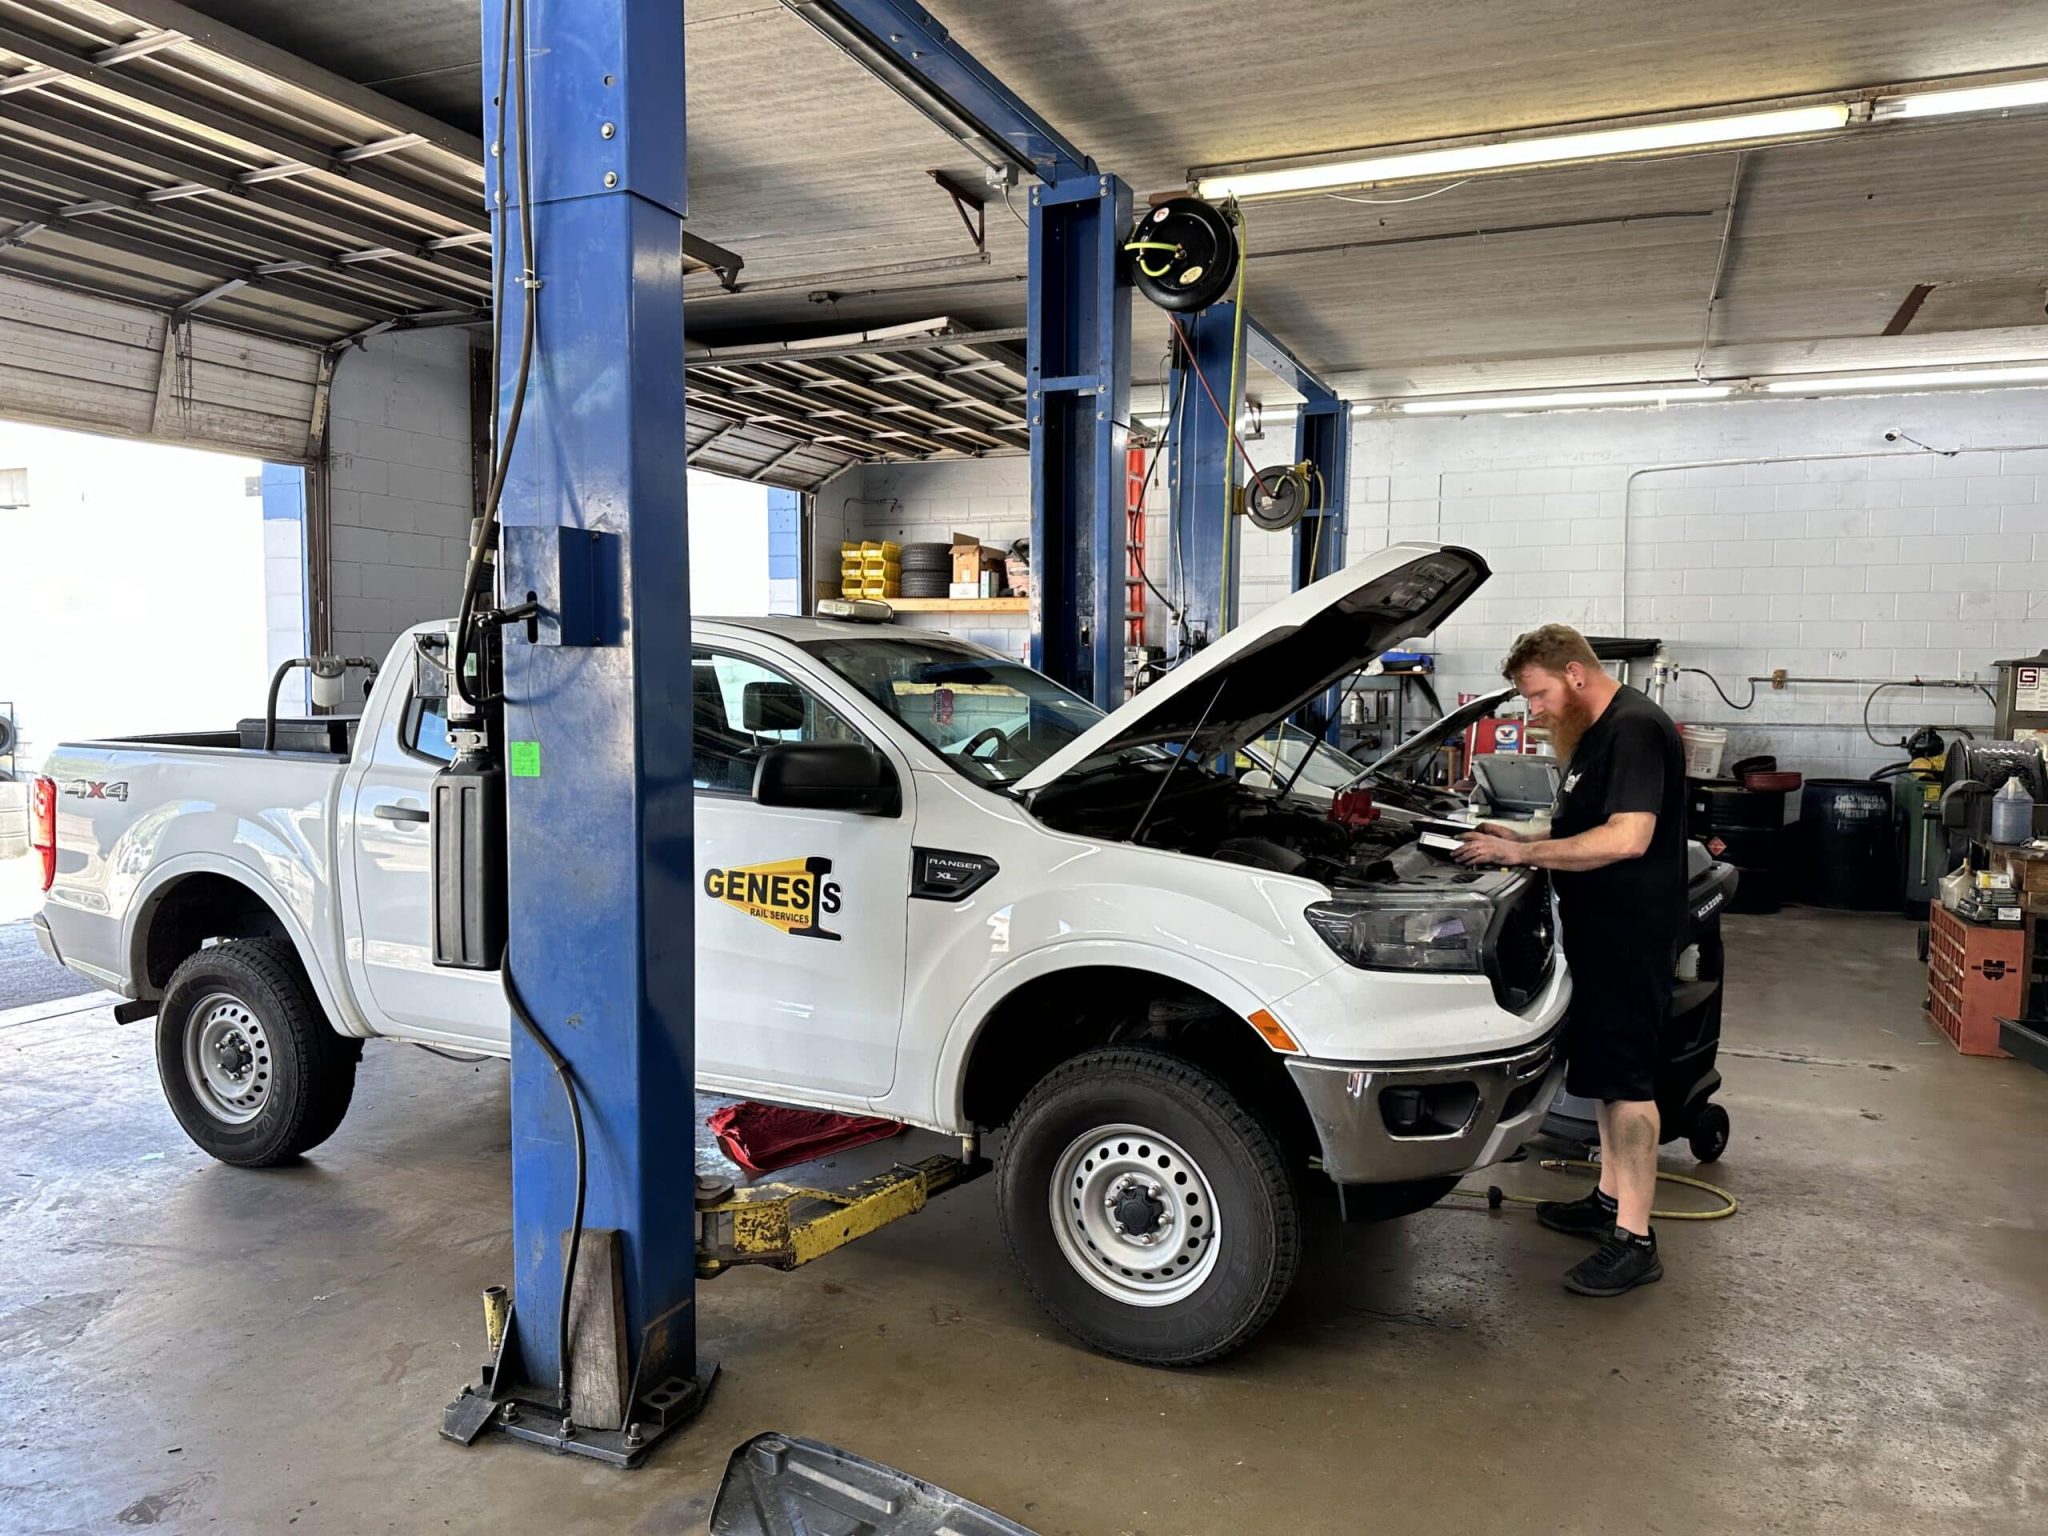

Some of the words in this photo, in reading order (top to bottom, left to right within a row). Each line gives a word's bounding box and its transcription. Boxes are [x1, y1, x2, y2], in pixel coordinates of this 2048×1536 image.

[929, 858, 982, 870] RANGER
[936, 871, 958, 881] XL
[704, 857, 841, 941] GENESIS
[750, 907, 769, 918] RAIL
[770, 910, 810, 924] SERVICES
